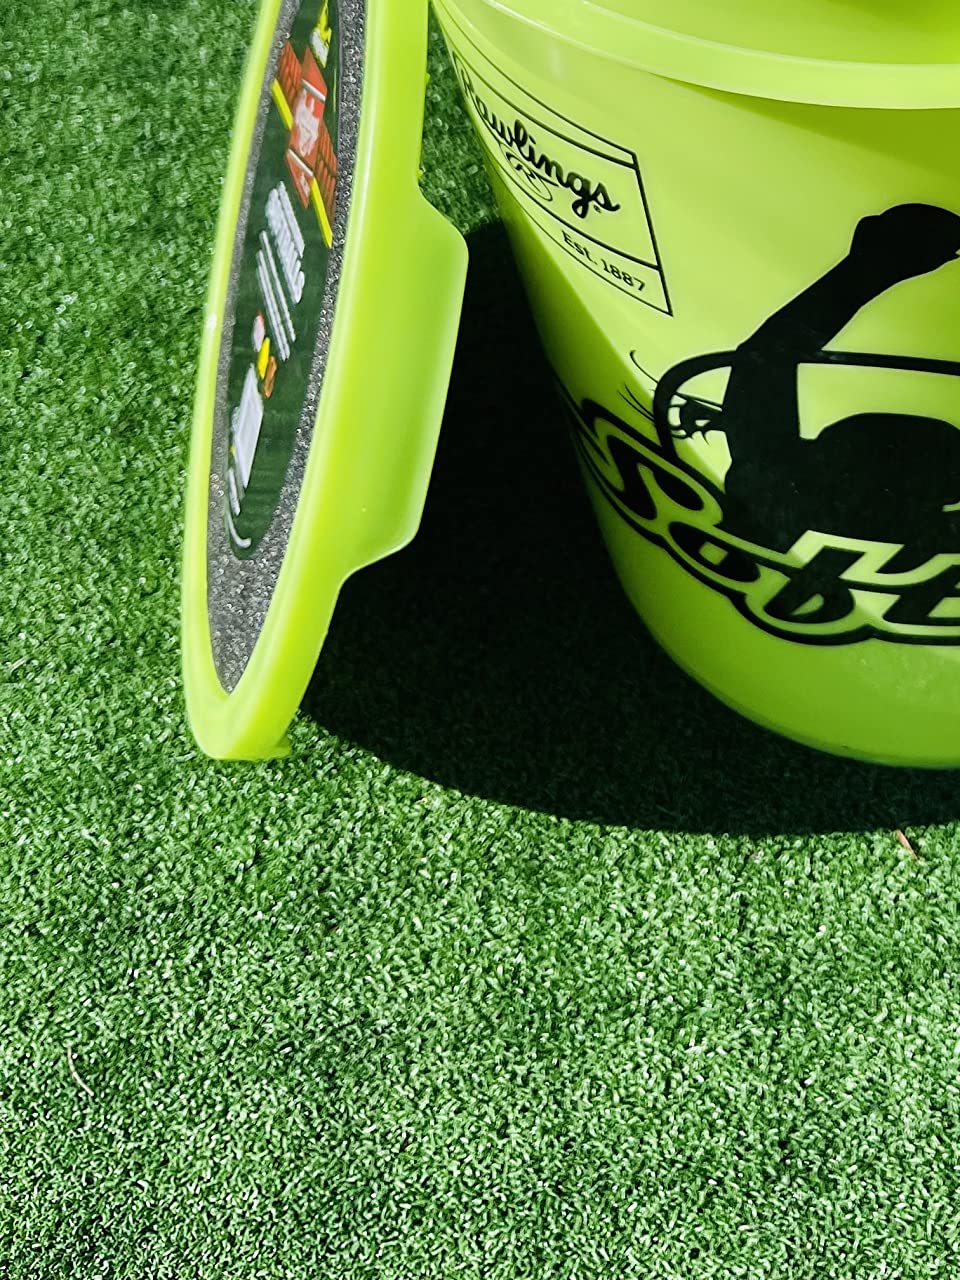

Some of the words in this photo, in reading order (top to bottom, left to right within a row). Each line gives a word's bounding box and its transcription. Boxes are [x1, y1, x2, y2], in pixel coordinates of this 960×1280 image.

[458, 66, 621, 219] Rawlings
[561, 229, 598, 265] Est.
[601, 259, 646, 292] 1887
